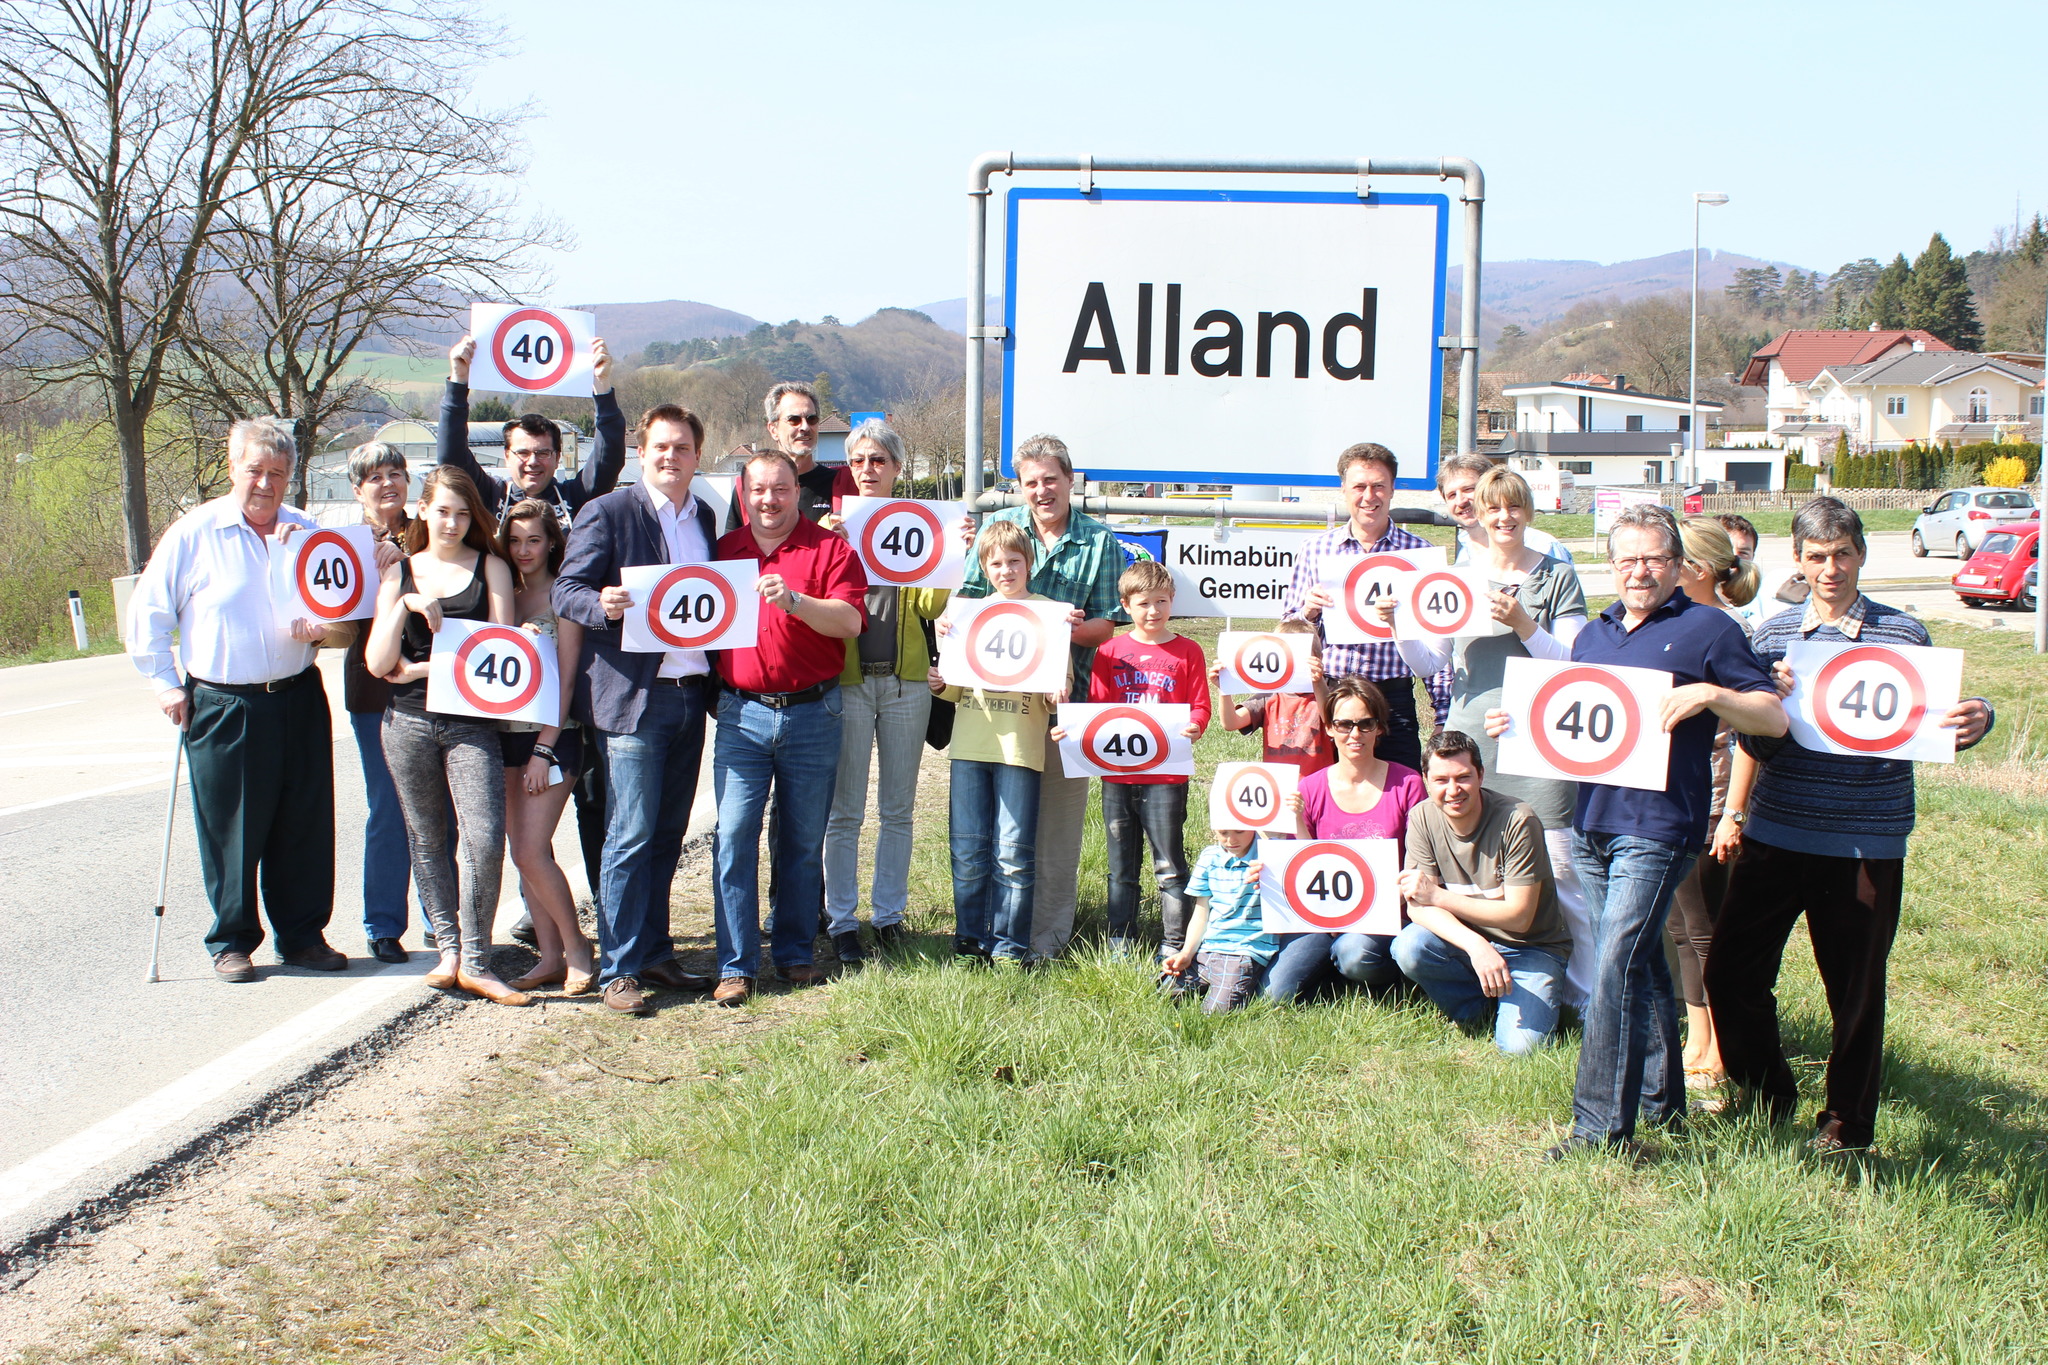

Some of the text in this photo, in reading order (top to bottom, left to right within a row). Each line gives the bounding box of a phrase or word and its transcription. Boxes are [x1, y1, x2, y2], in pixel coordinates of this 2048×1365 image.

[1063, 281, 1378, 381] Alland
[511, 335, 554, 366] 40
[880, 526, 924, 558] 40
[1179, 544, 1298, 568] Klimabün
[314, 557, 348, 590] 40
[1199, 576, 1289, 600] Gemein
[669, 594, 715, 624] 40
[1365, 582, 1393, 606] 4
[1427, 591, 1459, 614] 40
[985, 629, 1027, 660] 40
[475, 652, 521, 687] 40
[1249, 652, 1279, 674] 40
[1134, 671, 1177, 693] RACERS
[1839, 681, 1898, 721] 40
[1555, 701, 1614, 743] 40
[1103, 734, 1149, 757] 40
[1239, 786, 1268, 808] 40
[1305, 870, 1352, 902] 40
